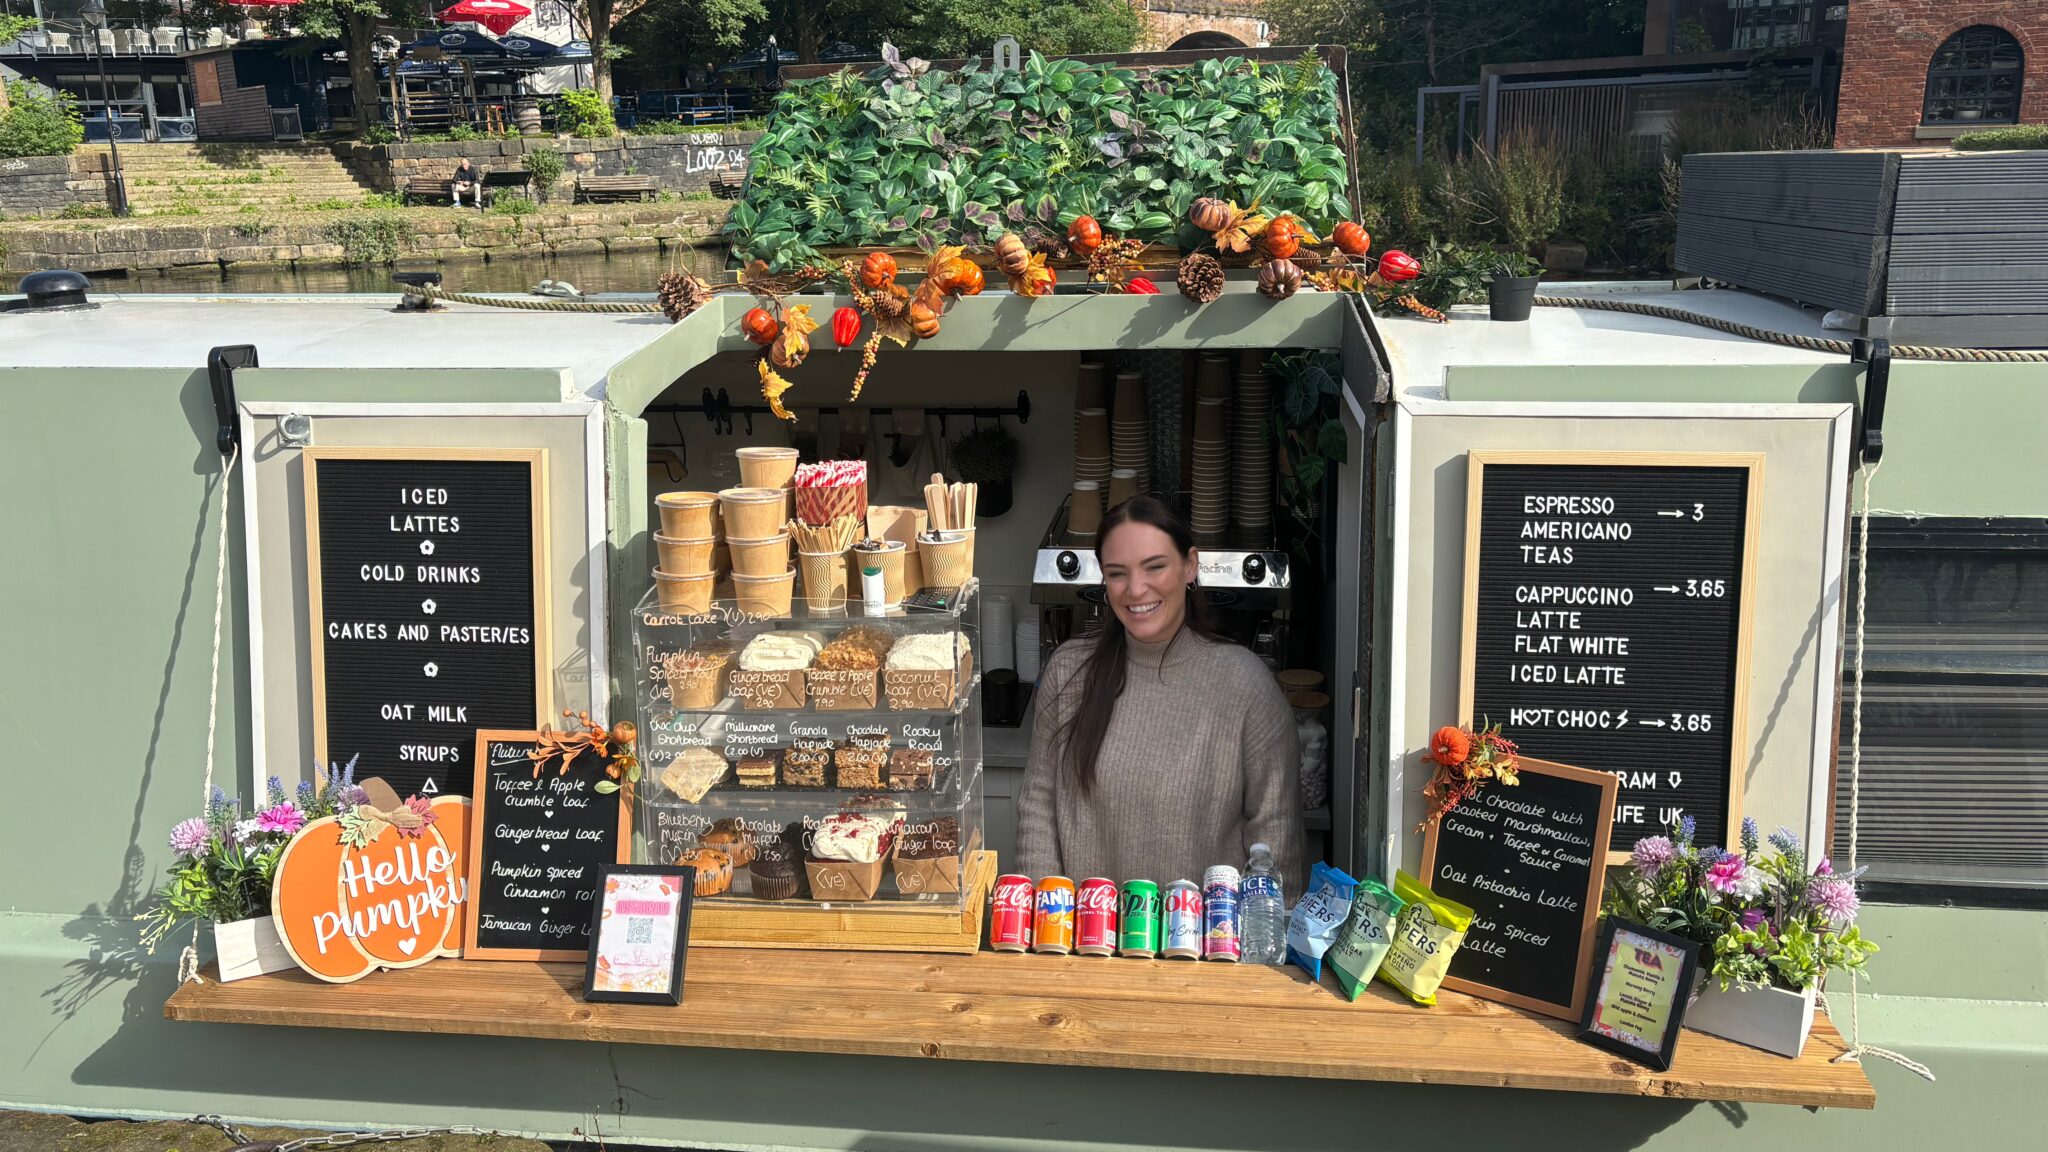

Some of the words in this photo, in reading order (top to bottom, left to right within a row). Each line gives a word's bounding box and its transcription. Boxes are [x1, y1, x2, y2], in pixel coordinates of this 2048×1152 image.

[401, 488, 448, 505] ICED
[1524, 496, 1615, 516] ESPRESSO
[1692, 503, 1704, 522] 3
[390, 515, 460, 533] LATTES
[1520, 521, 1632, 541] AMERICANO
[1520, 545, 1574, 564] TEAS
[360, 564, 405, 582] COLD
[417, 566, 481, 584] DRINKS
[1515, 586, 1634, 606] CAPPUCCINO
[643, 613, 688, 626] Carrot
[689, 613, 718, 625] Cake
[1516, 611, 1582, 629] LATTE
[328, 622, 388, 640] CAKES
[397, 624, 430, 642] AND
[1515, 636, 1563, 654] FLAT
[1569, 637, 1630, 656] WHITE
[646, 646, 700, 667] Pumpkin
[885, 671, 942, 684] Coconut
[1511, 664, 1557, 683] ICED
[1564, 666, 1626, 685] LATTE
[381, 704, 415, 721] OAT
[428, 706, 468, 723] MILK
[1557, 709, 1611, 728] CHOC
[1670, 713, 1712, 732] 3.65
[789, 721, 828, 736] Granola
[847, 724, 889, 735] Chocolate
[902, 724, 941, 742] Rocky
[399, 745, 460, 763] SYRUPS
[909, 739, 943, 751] Road
[493, 772, 534, 794] Toffee
[549, 777, 586, 796] Apple
[1552, 811, 1584, 826] with
[1659, 807, 1684, 826] UK
[495, 823, 570, 844] Gingerbread
[1446, 818, 1484, 840] Cream
[1503, 832, 1541, 853] Toffee
[1553, 848, 1591, 868] Caramel
[342, 842, 457, 898] Hello
[491, 860, 543, 880] Pumpkin
[503, 883, 566, 901] Cinnamon
[1243, 877, 1267, 892] ICE
[1441, 864, 1467, 884] Oat
[1473, 874, 1531, 902] Pistachio
[1537, 890, 1578, 912] Latte
[480, 914, 532, 932] Jamaican
[539, 919, 576, 939] Ginger
